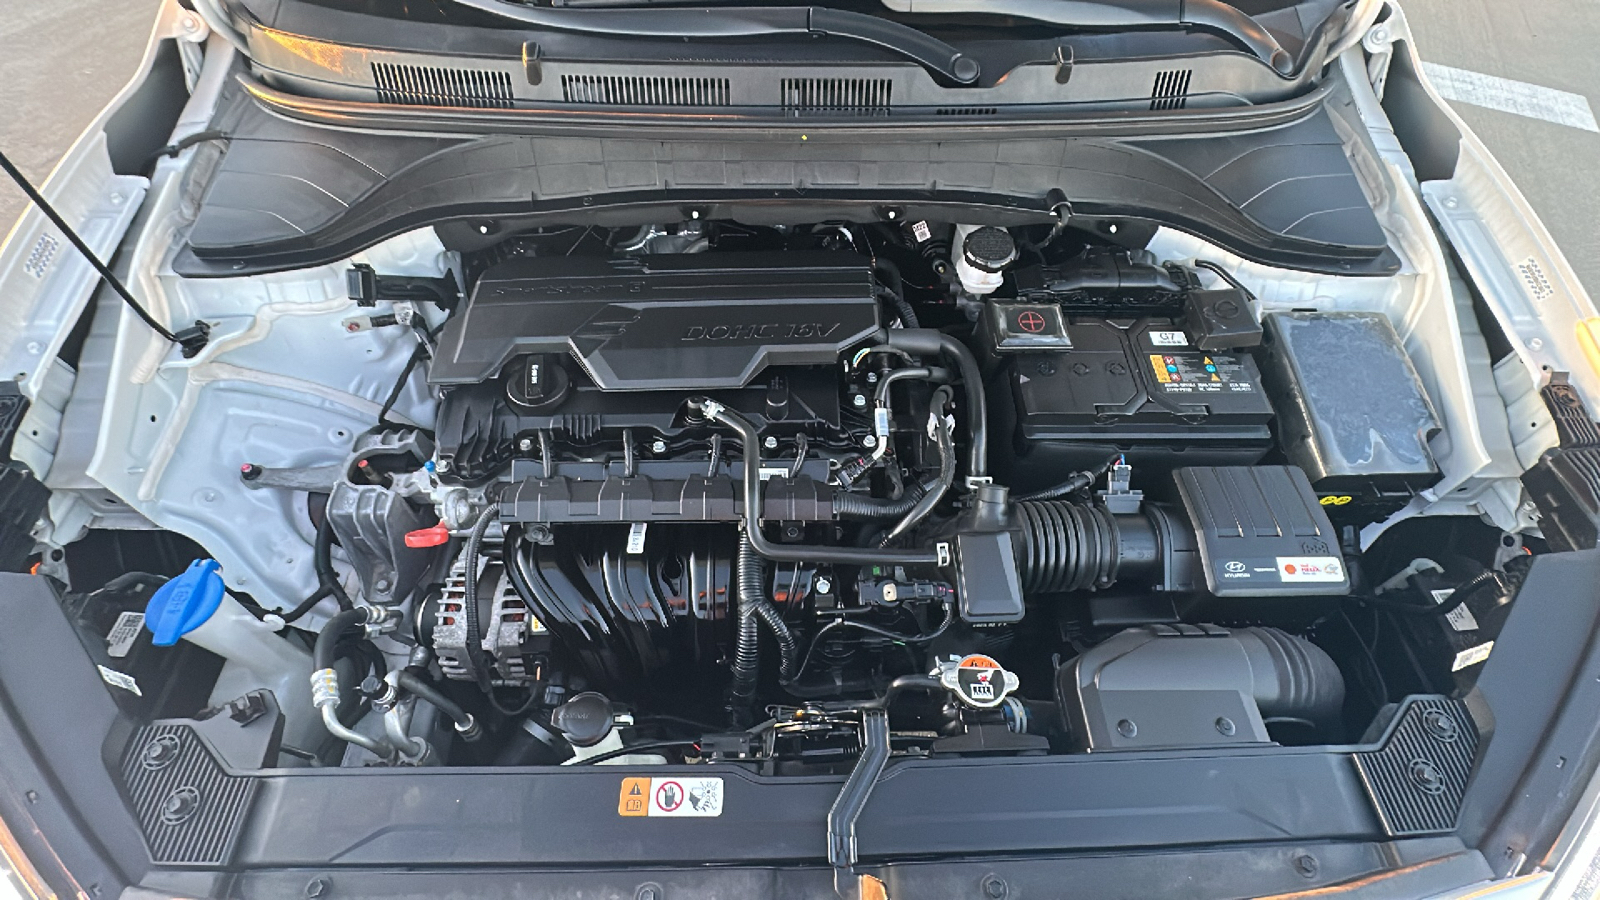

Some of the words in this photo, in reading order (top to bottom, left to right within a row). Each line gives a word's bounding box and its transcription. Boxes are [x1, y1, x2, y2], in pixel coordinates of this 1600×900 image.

[681, 323, 779, 341] DOHC
[784, 322, 841, 338] 16V
[1159, 332, 1176, 341] G7
